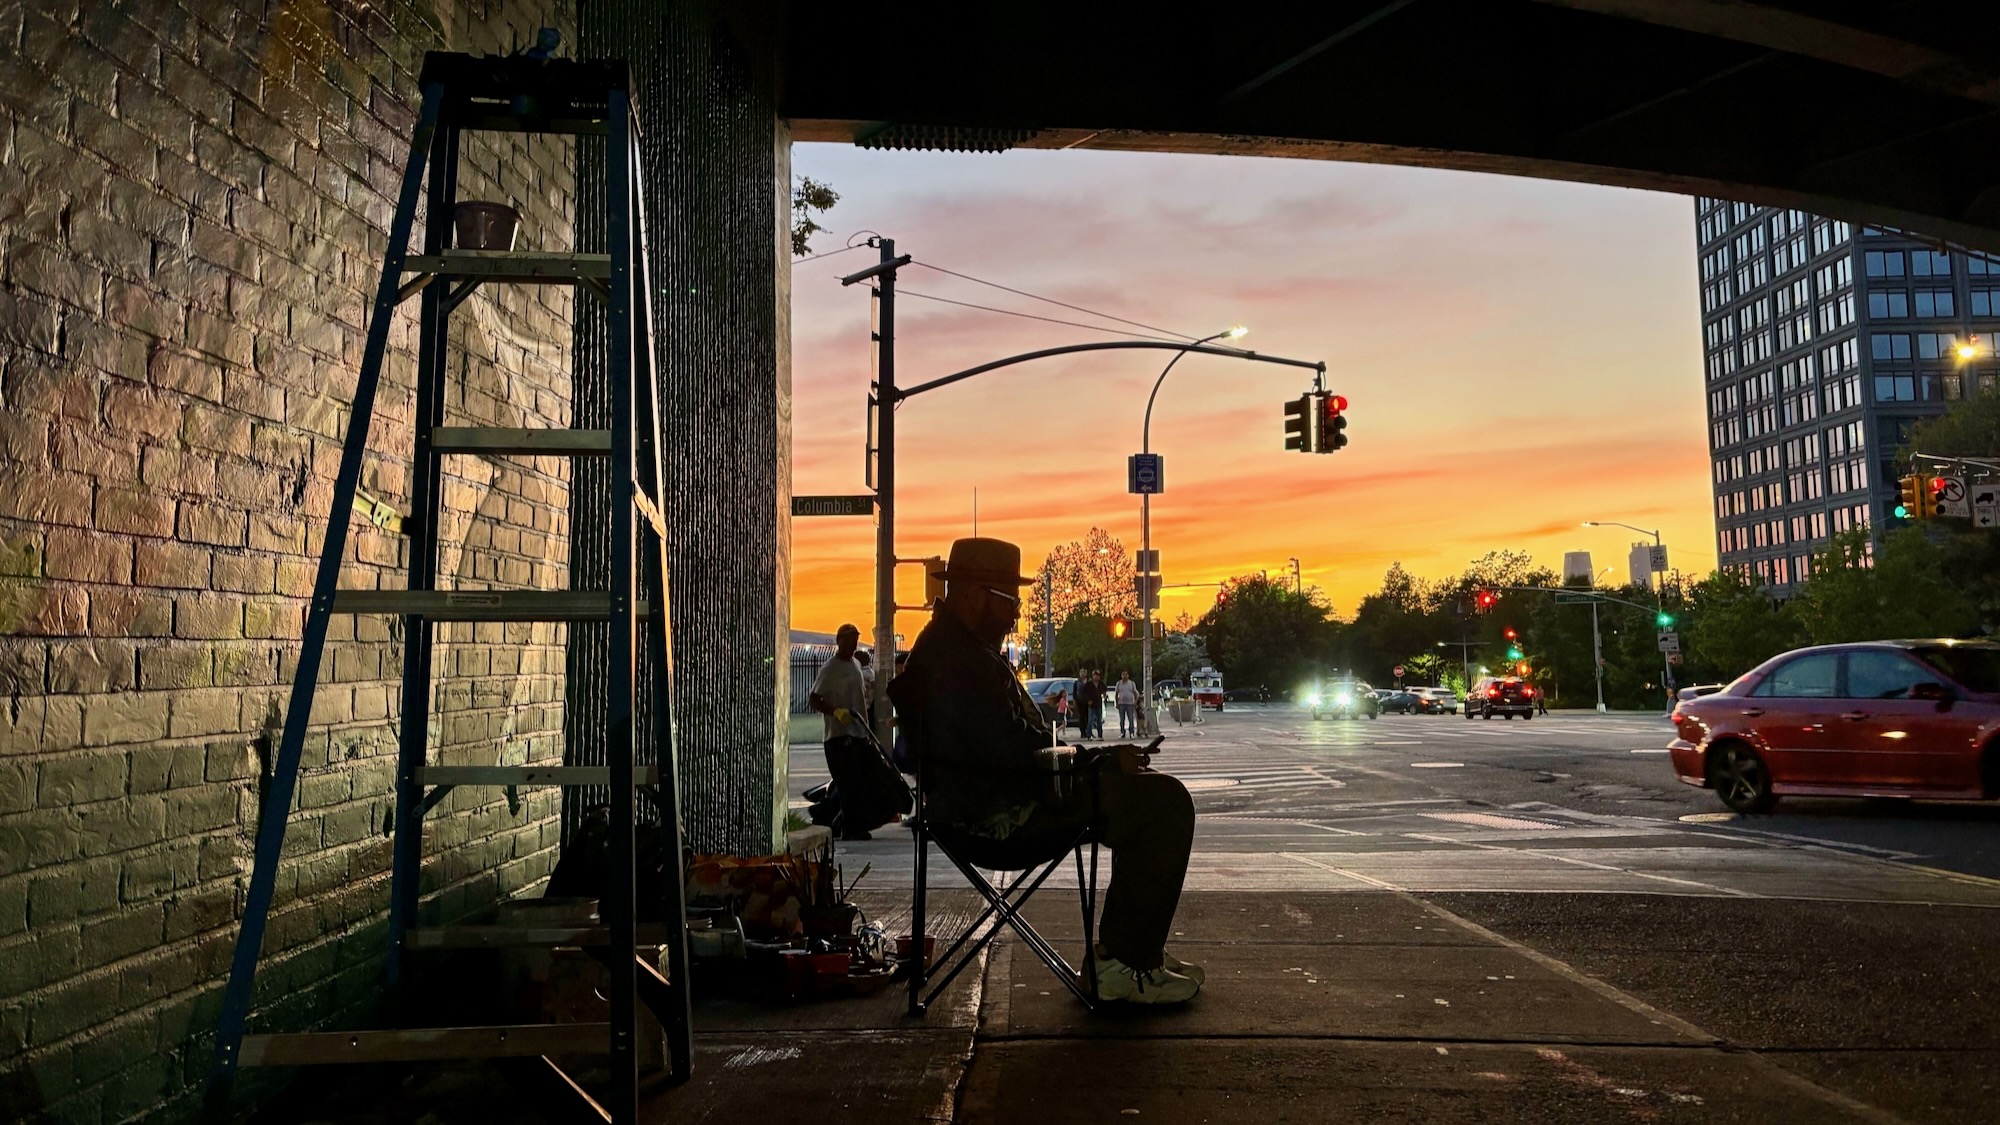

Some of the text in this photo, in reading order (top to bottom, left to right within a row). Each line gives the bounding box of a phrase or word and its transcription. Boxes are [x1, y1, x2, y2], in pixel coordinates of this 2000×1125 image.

[796, 498, 866, 514] Columbia St
[1653, 555, 1666, 564] 25
